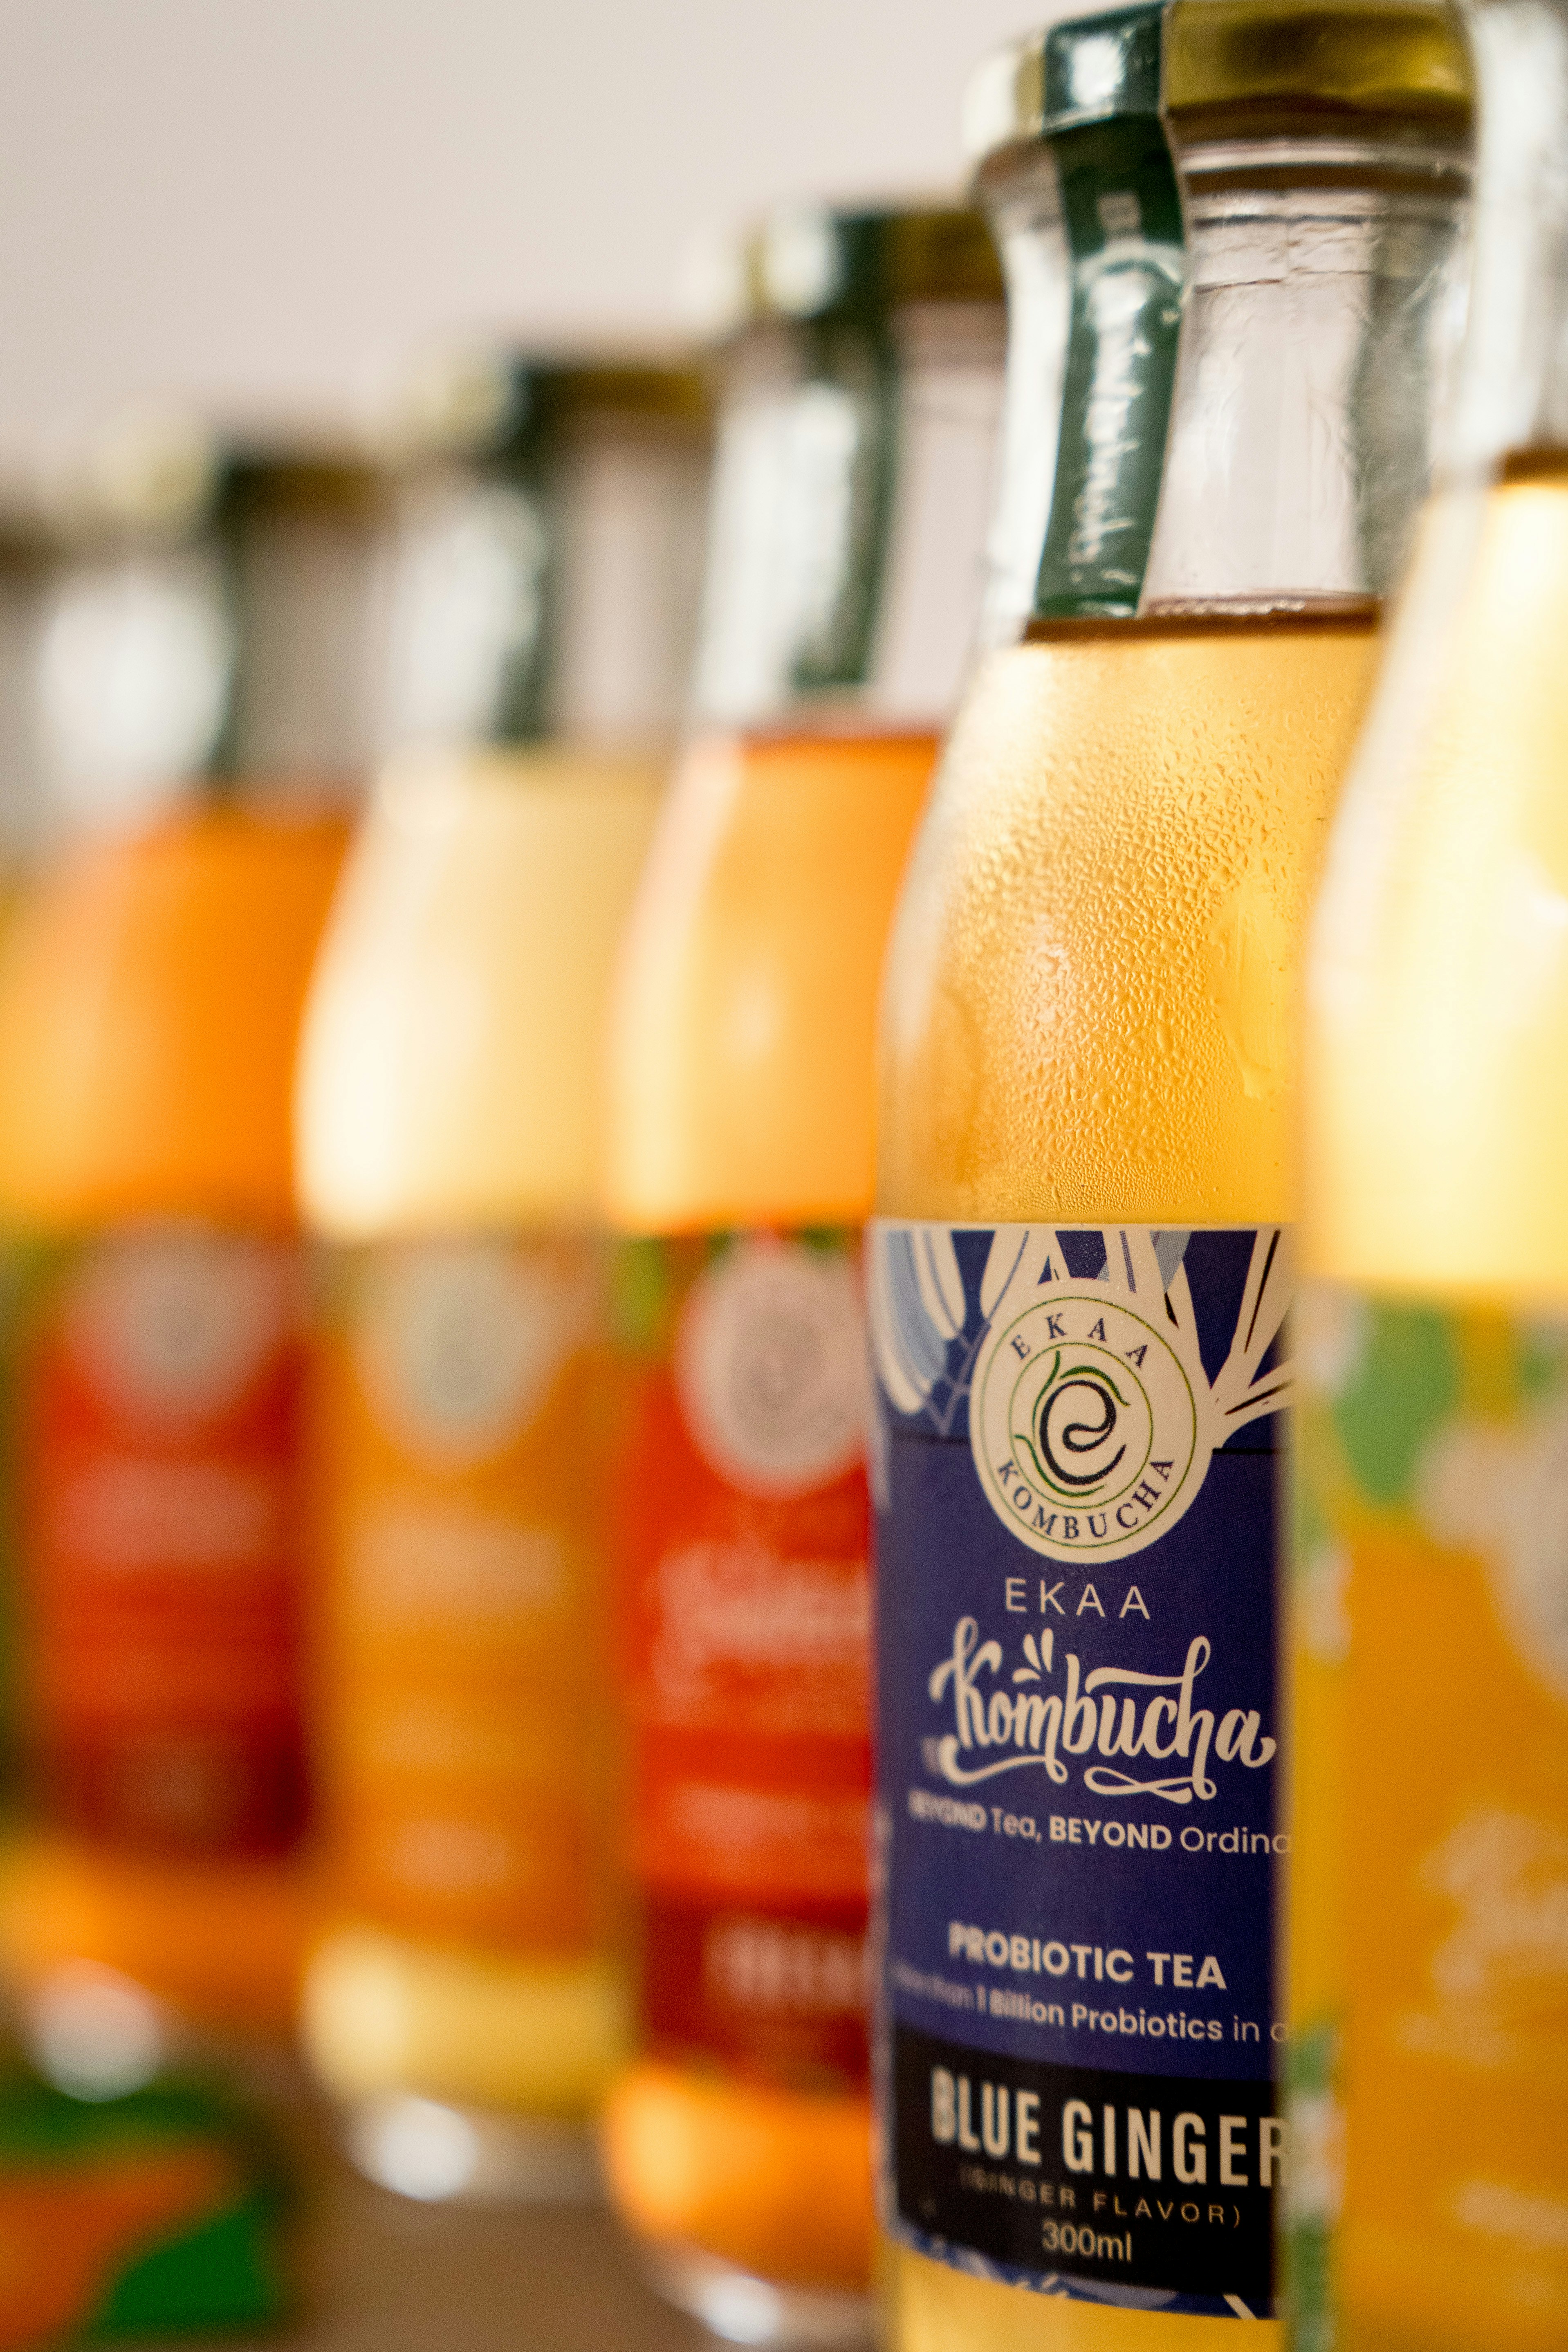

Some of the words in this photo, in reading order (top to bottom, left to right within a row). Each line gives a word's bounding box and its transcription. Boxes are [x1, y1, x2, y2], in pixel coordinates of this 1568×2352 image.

[1010, 1313, 1148, 1368] EKAA
[998, 1459, 1174, 1540] KOMBUCHA
[1005, 1577, 1151, 1620] EKAA
[926, 1615, 1277, 1804] Kombucha
[990, 1806, 1042, 1843] Tea,
[1049, 1815, 1173, 1852] BEYOND
[949, 1920, 1135, 1983] PROBIOTIC
[1146, 1951, 1227, 1990] TEA
[989, 1988, 1065, 2027] Billion
[1072, 2002, 1223, 2042] Probiotics
[1233, 2015, 1260, 2042] in
[931, 2065, 1042, 2166] BLUE
[1063, 2099, 1291, 2188] GINGER
[1092, 2190, 1241, 2228] FLAVOR)
[1041, 2217, 1133, 2262] 300ml
